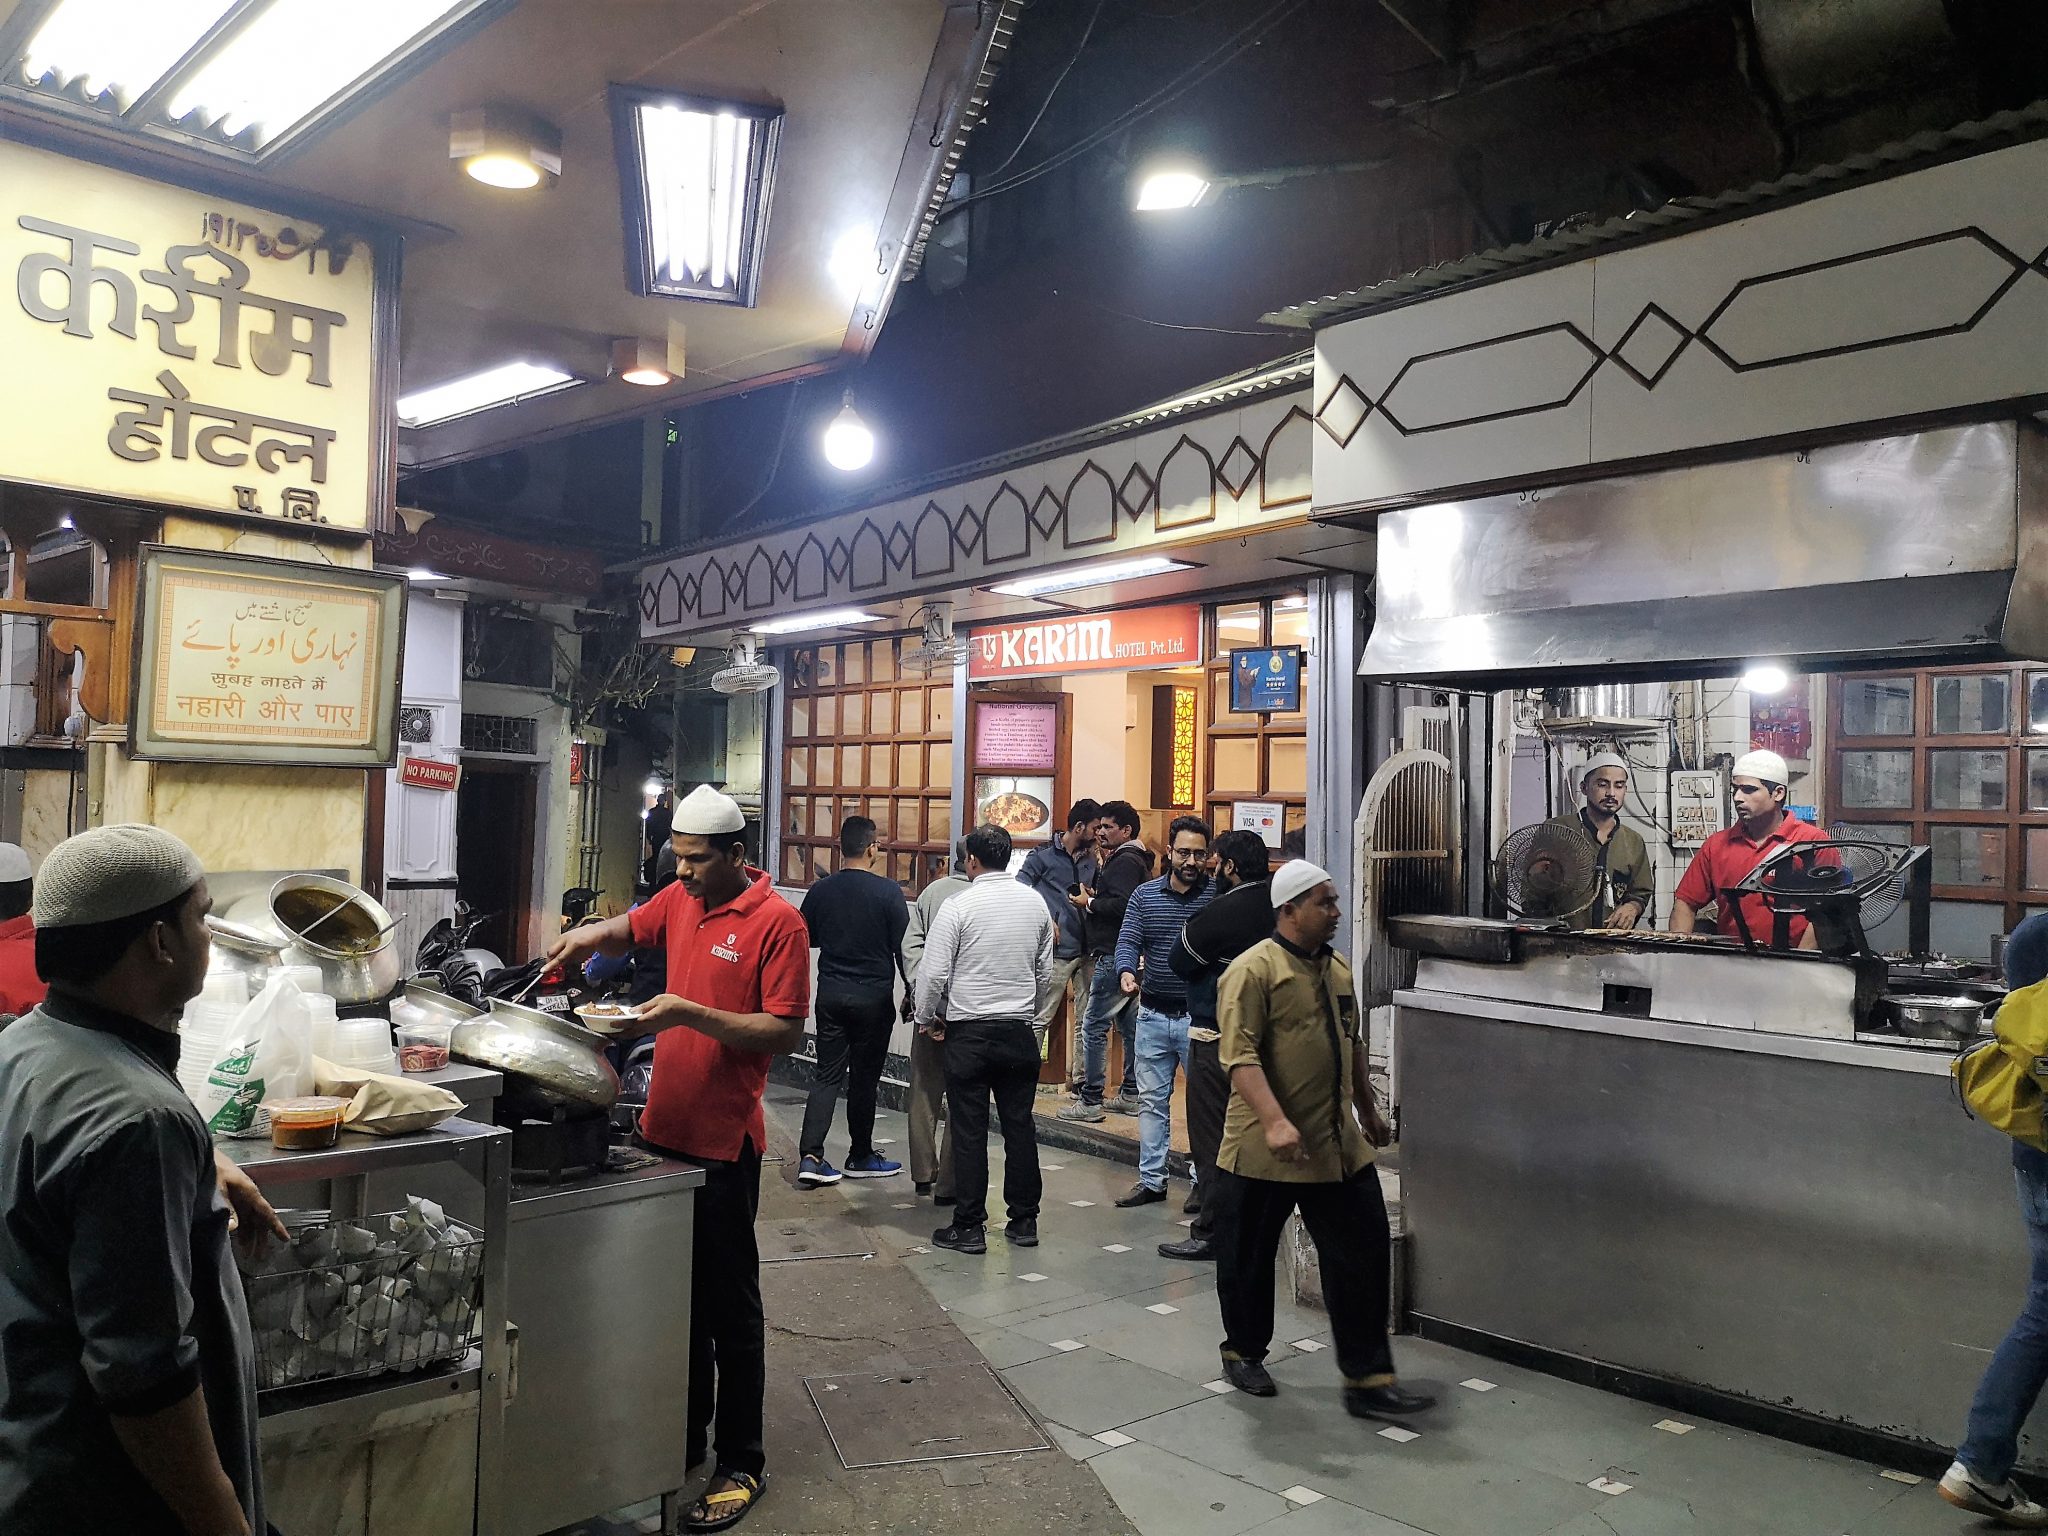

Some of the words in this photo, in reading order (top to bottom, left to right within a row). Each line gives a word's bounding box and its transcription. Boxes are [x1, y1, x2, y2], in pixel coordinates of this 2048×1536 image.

[17, 214, 347, 388] करीम
[107, 369, 337, 484] होटल
[248, 630, 286, 655] اور
[291, 627, 358, 671] نہاری
[1115, 642, 1147, 658] HOTEL
[1150, 640, 1166, 655] Pvt.
[1168, 637, 1184, 654] Ltd.
[211, 672, 255, 689] सुबह
[311, 676, 327, 691] में
[176, 691, 246, 719] नहारी
[258, 694, 304, 722] और
[315, 703, 355, 727] पाए
[406, 765, 418, 777] NO
[420, 766, 454, 783] PARKING
[1242, 817, 1255, 827] VISA
